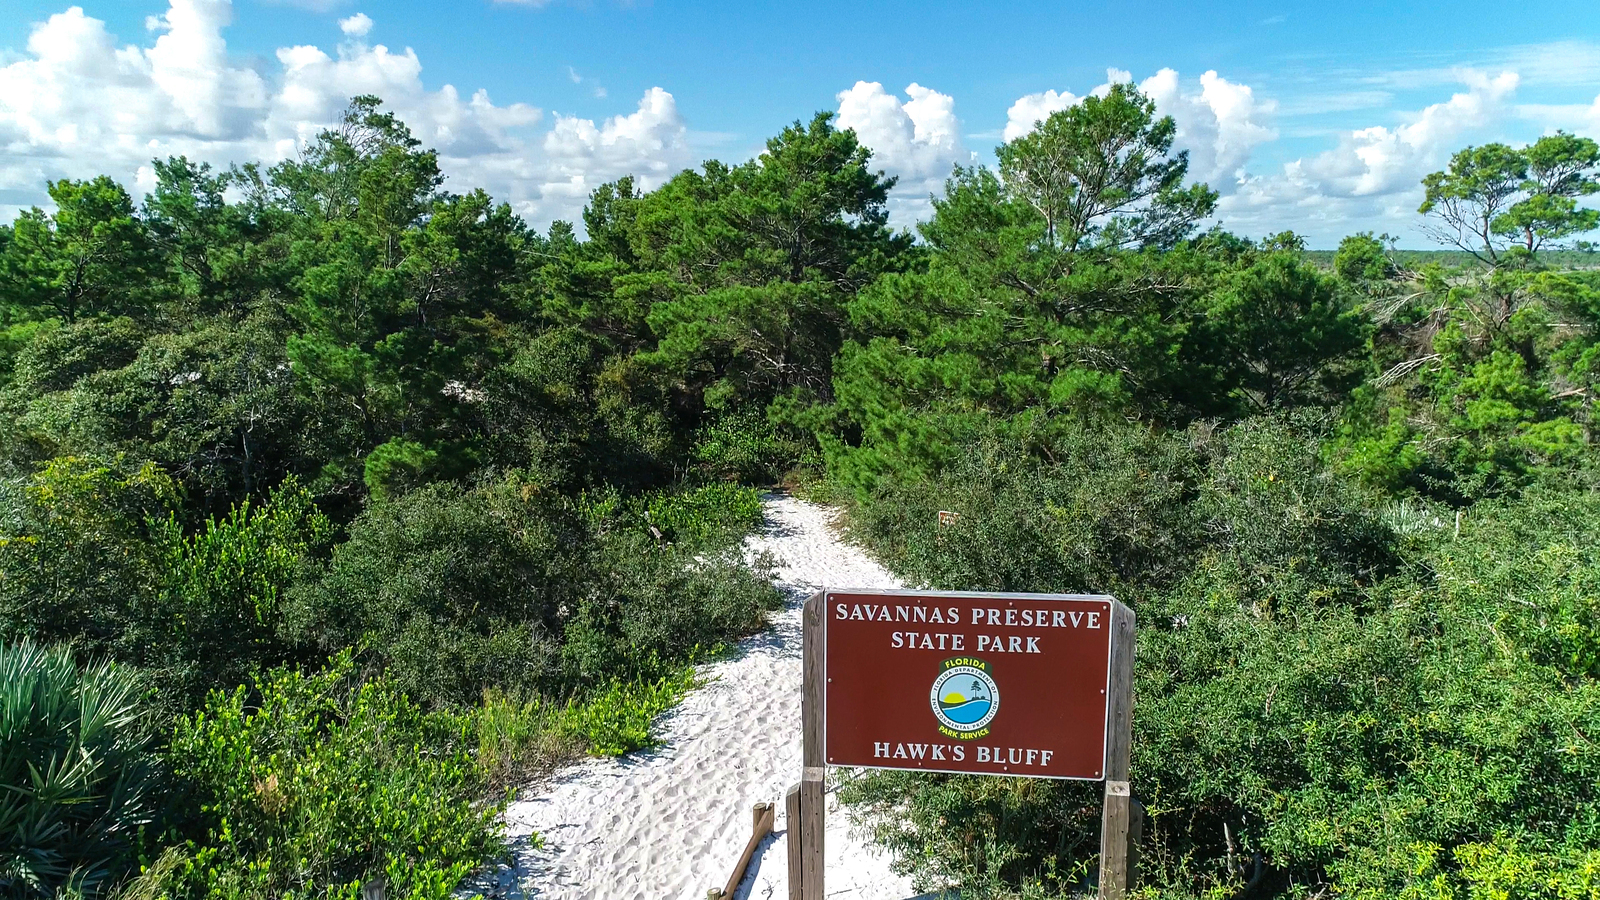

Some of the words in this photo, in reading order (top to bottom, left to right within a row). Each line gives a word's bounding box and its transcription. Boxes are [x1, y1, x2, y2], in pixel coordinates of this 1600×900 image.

[836, 603, 960, 625] SAVANNAS
[971, 608, 1101, 629] PRESERVE
[891, 632, 965, 651] STATE
[977, 635, 1041, 654] PARK
[945, 658, 985, 670] FLORIDA
[933, 670, 953, 691] FLORIDA
[954, 668, 992, 686] DEPARTMENT
[932, 698, 970, 730] ENVIRONMENTAL
[972, 700, 998, 728] PROTECTION
[938, 725, 958, 738] PARK
[960, 728, 989, 740] SERVICE
[873, 741, 965, 762] HAWK'S
[976, 747, 1054, 767] BLUFF
